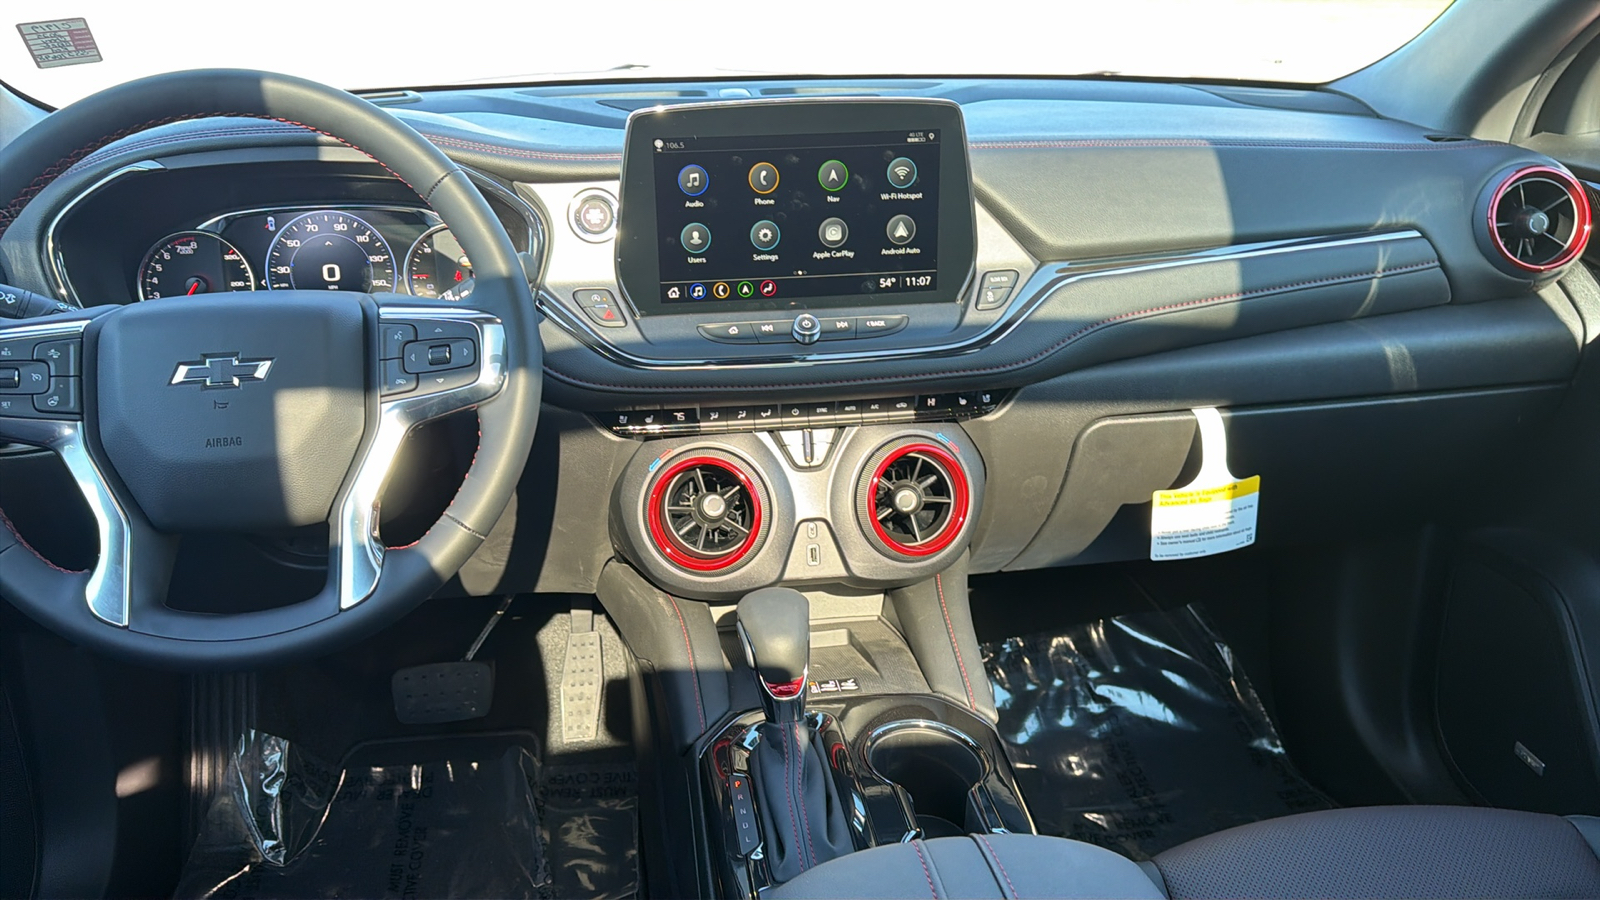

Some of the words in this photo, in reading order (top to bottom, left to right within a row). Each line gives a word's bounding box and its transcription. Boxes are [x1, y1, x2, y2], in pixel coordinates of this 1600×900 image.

[898, 192, 923, 200] Hotspot
[752, 254, 779, 262] Settings
[831, 250, 855, 258] CarPlay
[322, 264, 340, 281] 0
[906, 276, 931, 286] 11:07
[205, 436, 242, 448] AIRBAG
[548, 772, 600, 784] COVER
[394, 803, 415, 856] REMOVE
[408, 826, 428, 871] COVER
[388, 864, 404, 892] MUST
